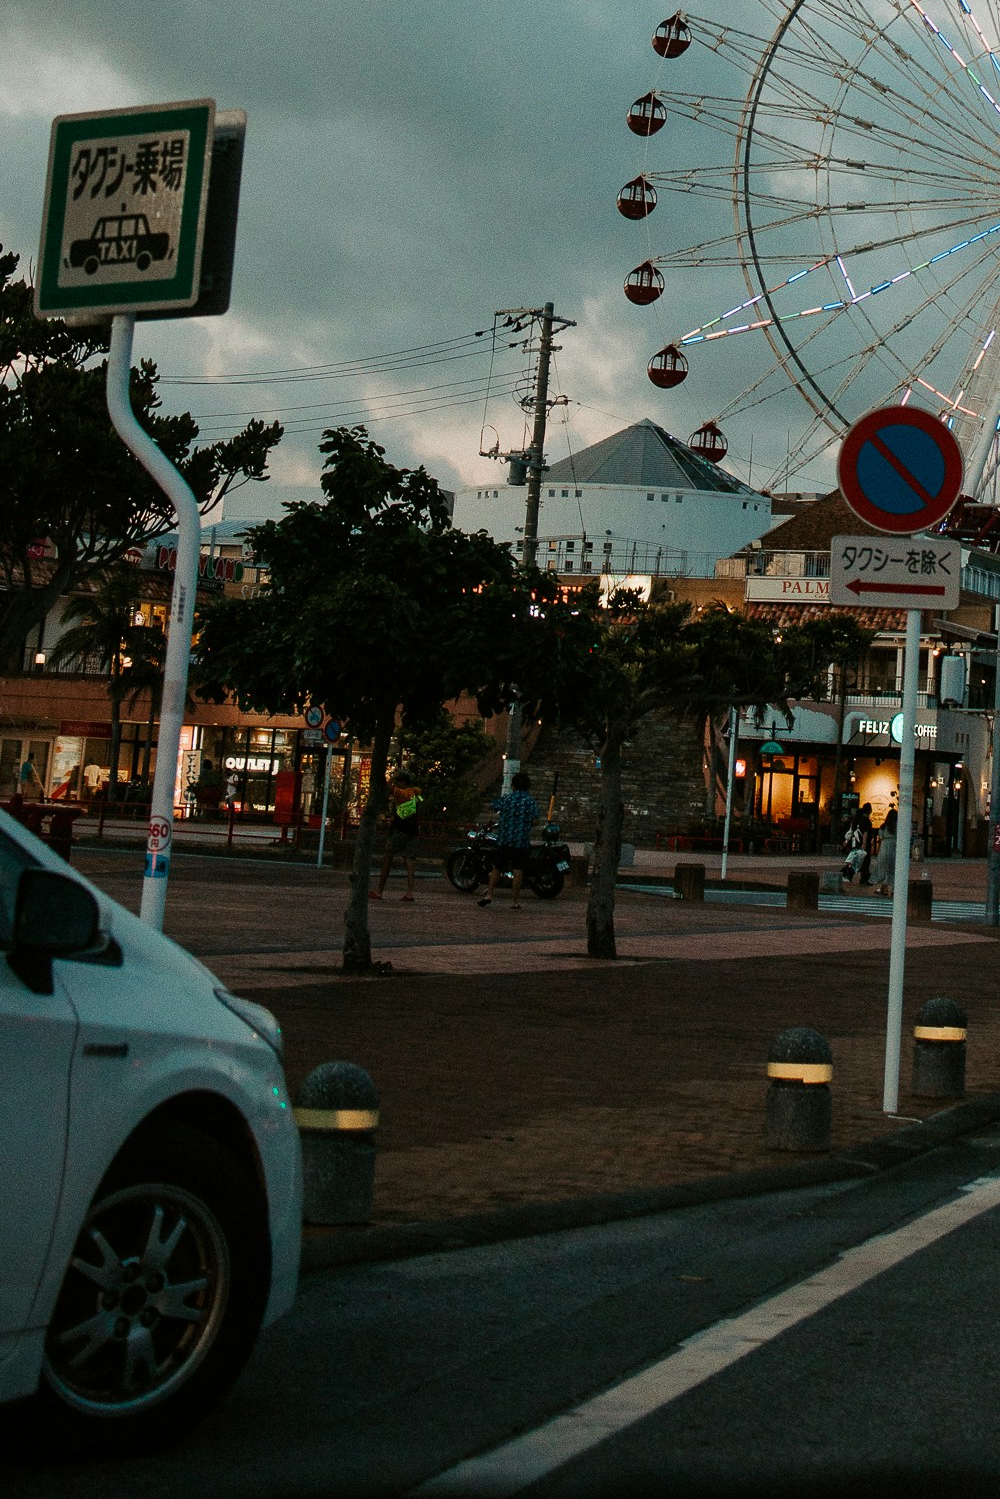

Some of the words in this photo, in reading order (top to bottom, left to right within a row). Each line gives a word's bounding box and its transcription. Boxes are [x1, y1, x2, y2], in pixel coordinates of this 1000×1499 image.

[72, 138, 185, 201] タクシー乗場
[99, 240, 137, 261] TAXI
[841, 546, 952, 575] タクシーを除く
[859, 720, 890, 734] FELIZ
[913, 723, 938, 738] COFFEE
